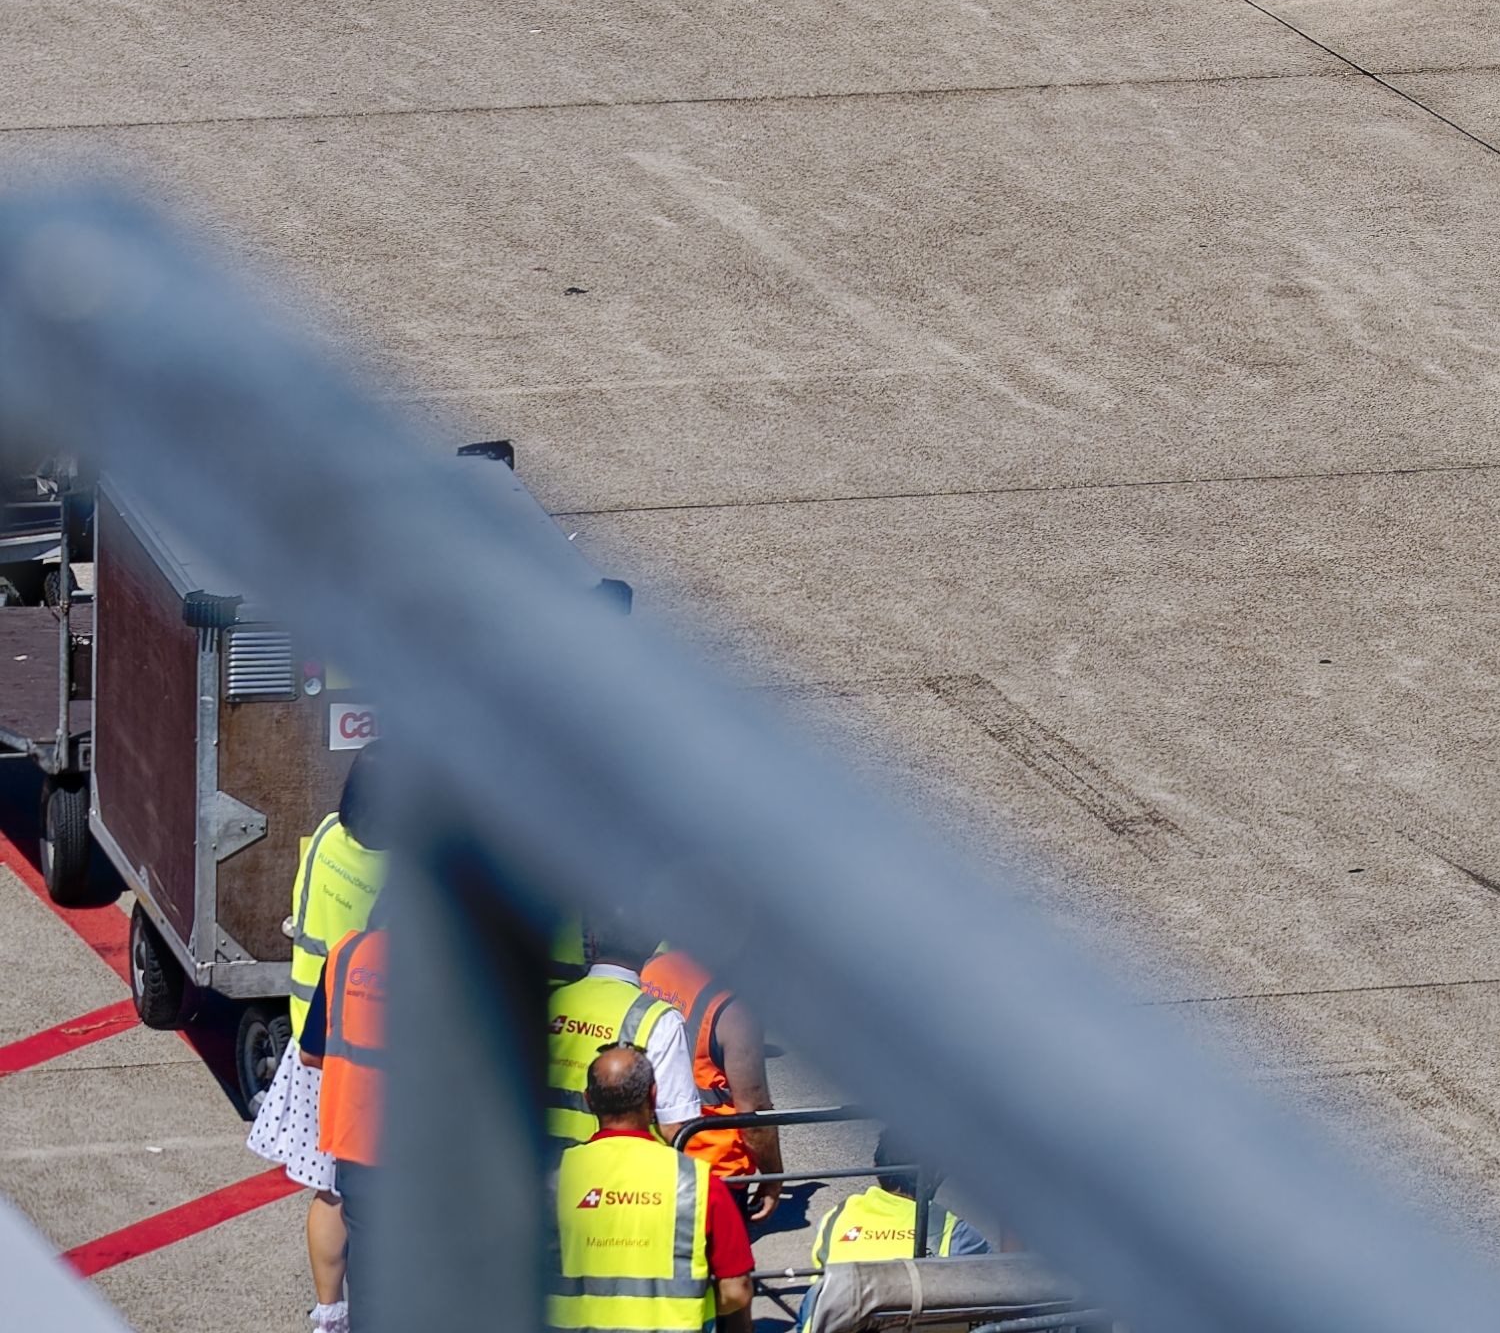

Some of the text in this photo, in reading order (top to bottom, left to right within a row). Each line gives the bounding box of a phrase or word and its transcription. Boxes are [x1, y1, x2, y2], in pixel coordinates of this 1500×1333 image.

[566, 1019, 613, 1040] SWISS
[605, 1191, 662, 1206] SWISS
[586, 1236, 650, 1247] Maintenance
[864, 1229, 917, 1241] SWISS
